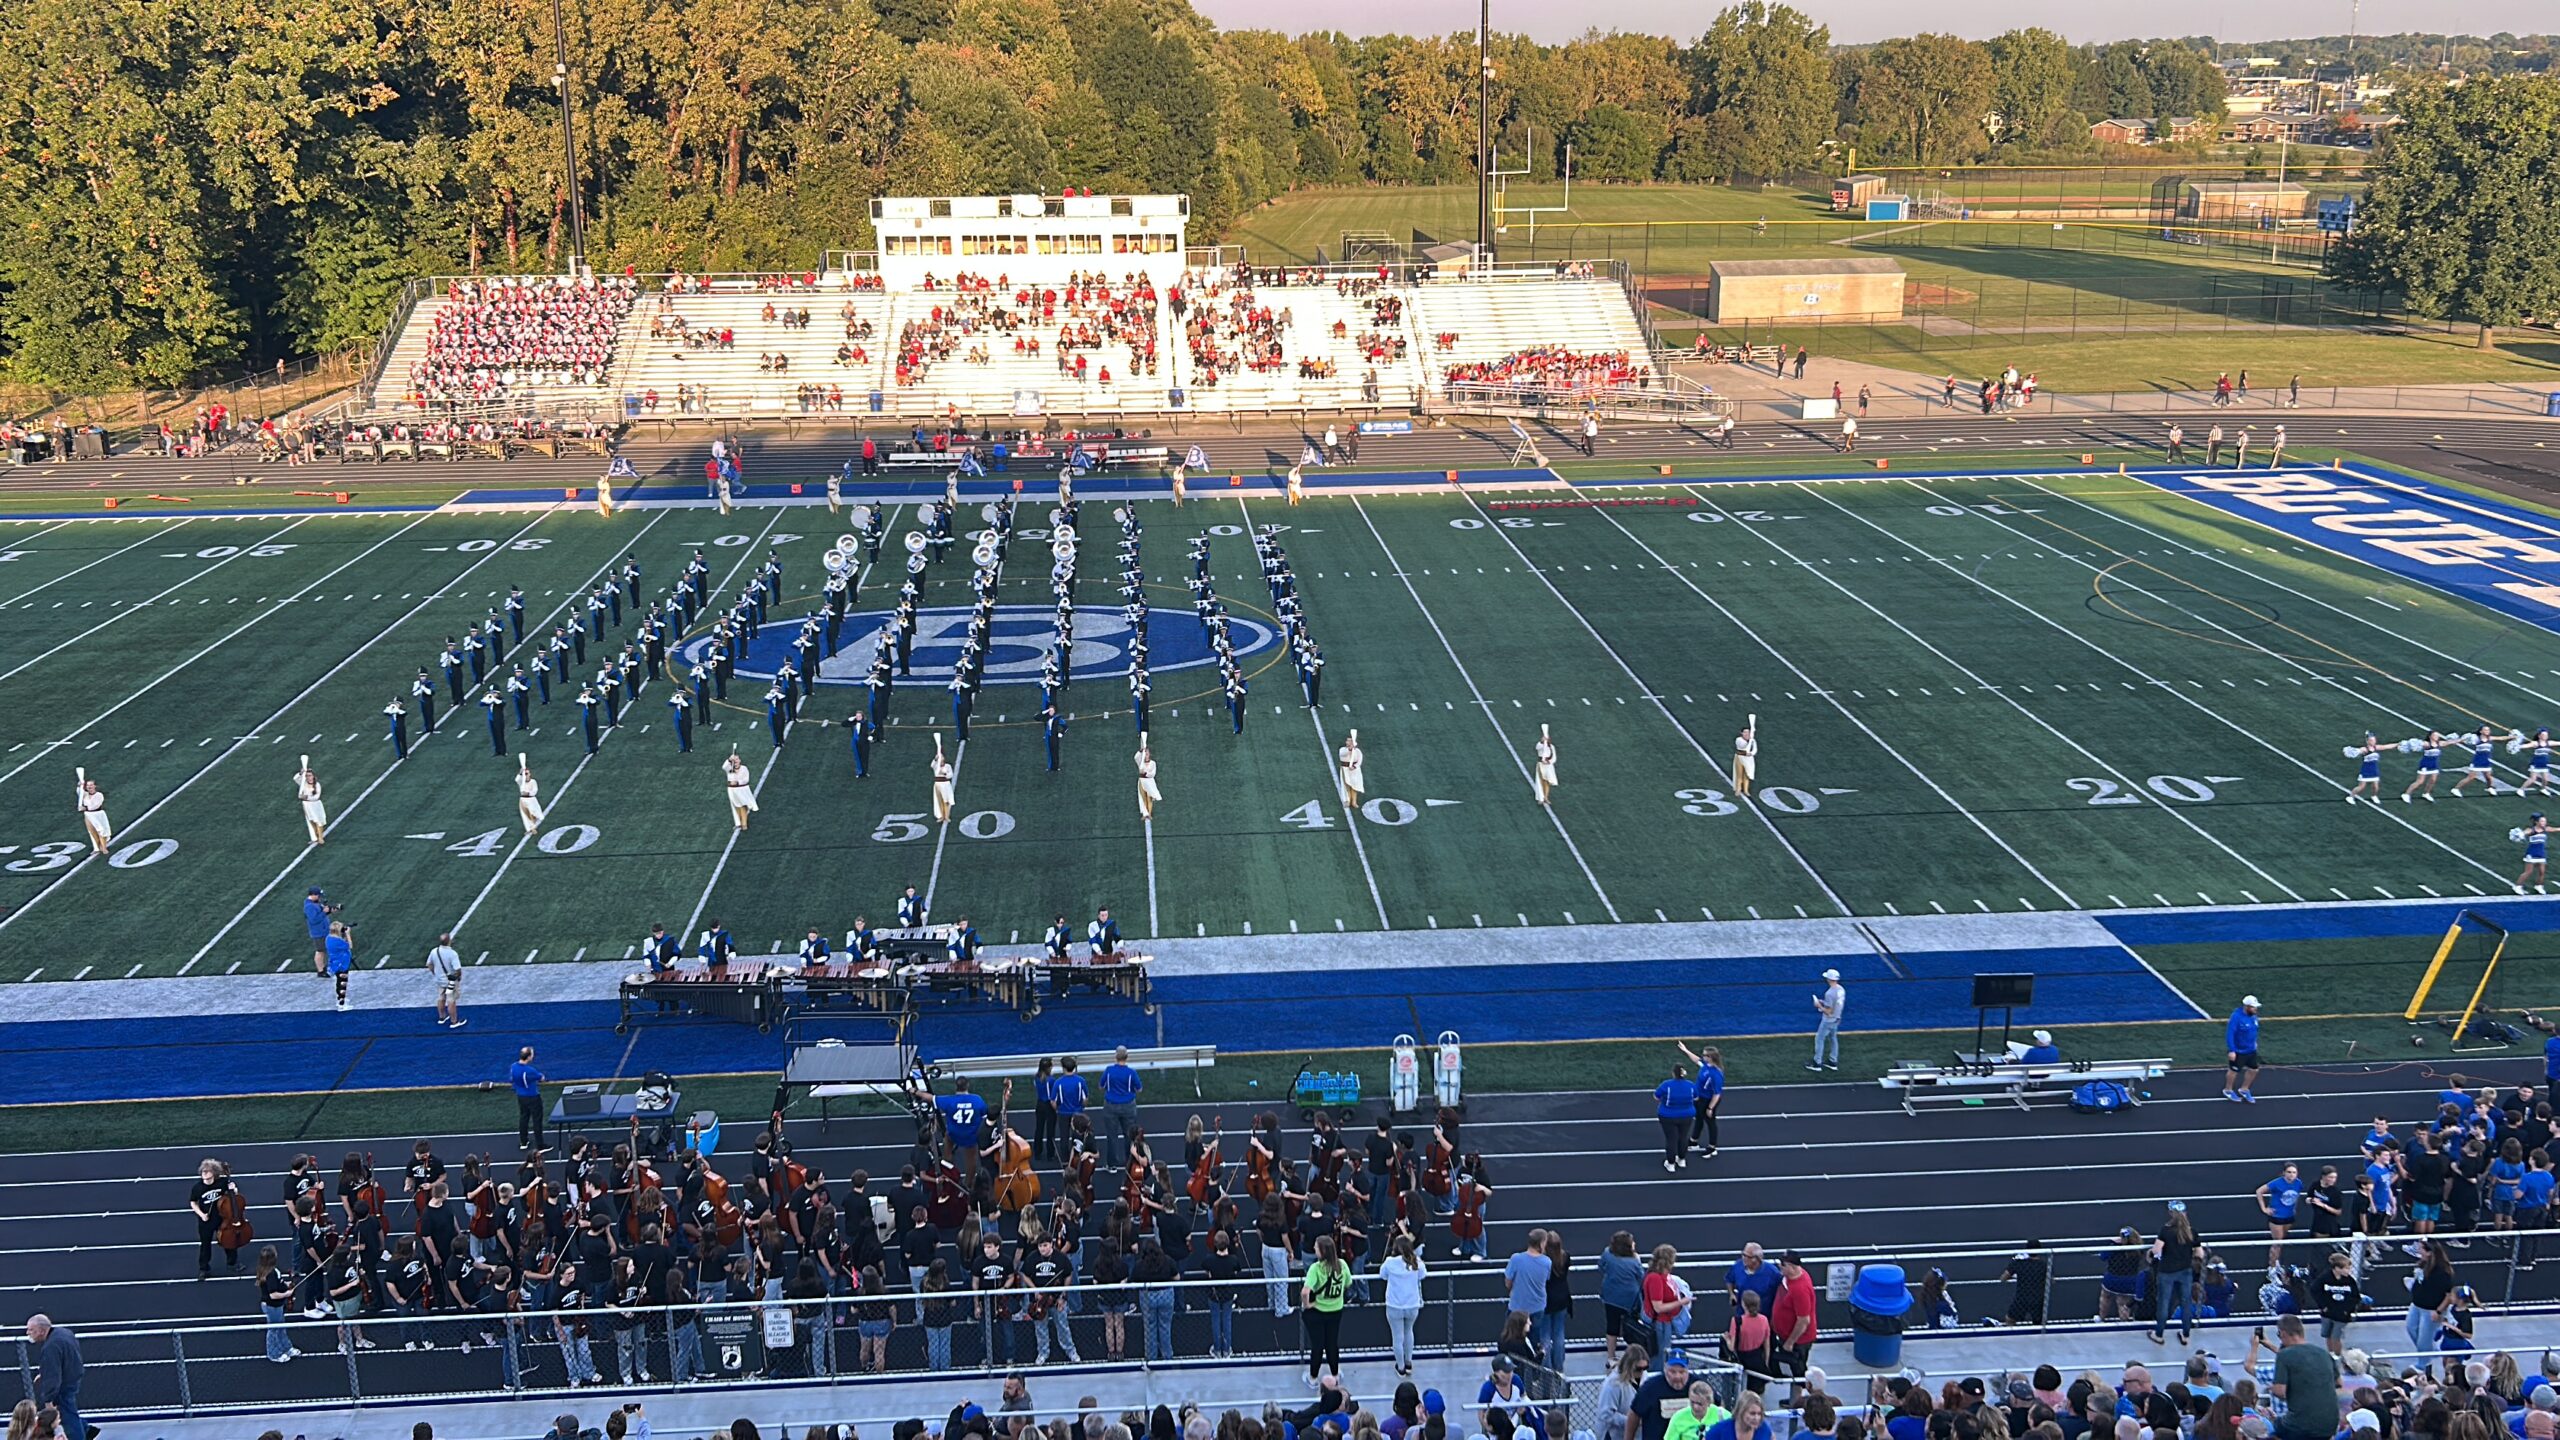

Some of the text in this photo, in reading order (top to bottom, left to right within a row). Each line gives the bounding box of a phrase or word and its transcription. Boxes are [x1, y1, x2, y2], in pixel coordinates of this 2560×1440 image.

[1449, 517, 1535, 529] 30
[1687, 510, 1775, 523] 20
[1925, 504, 2019, 516] 10
[2181, 474, 2560, 566] BLUE
[196, 544, 298, 558] 20
[456, 539, 553, 551] 30
[712, 533, 804, 546] 40
[817, 612, 1136, 676] B
[1673, 786, 1820, 816] 30
[2066, 775, 2215, 805] 20
[871, 810, 1016, 842] 50
[1280, 798, 1418, 829] 40
[5, 838, 179, 872] 30
[444, 824, 601, 857] 40
[953, 1109, 974, 1124] 47
